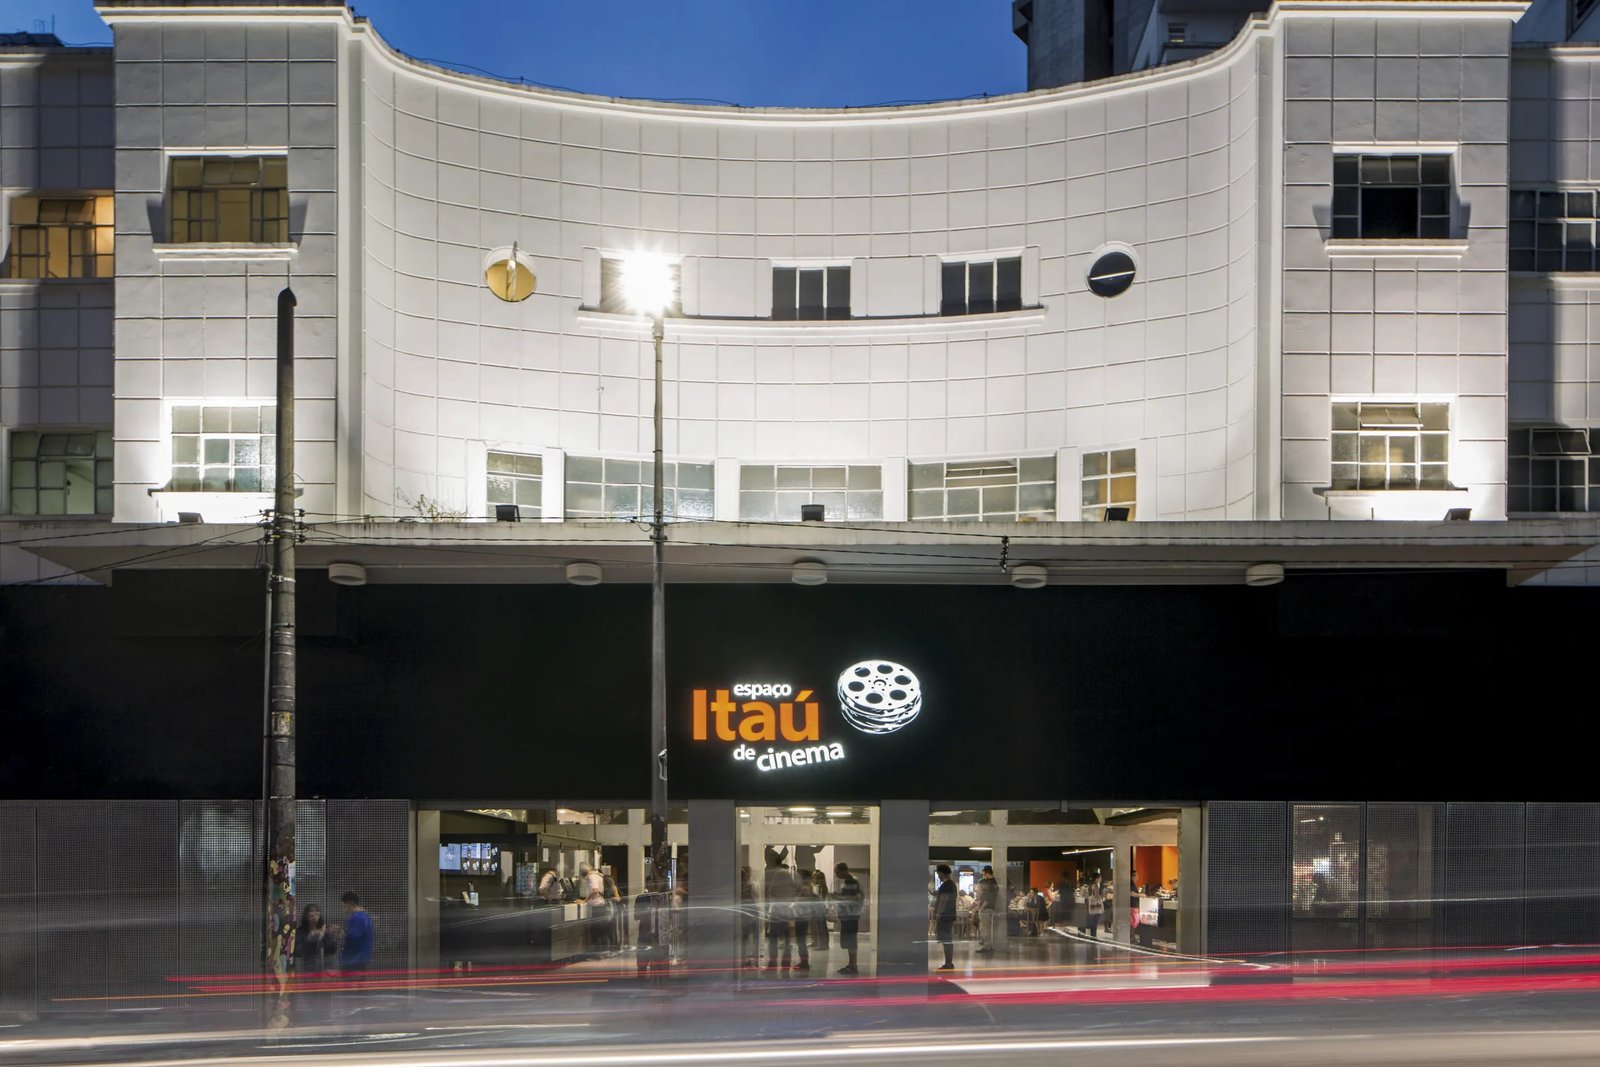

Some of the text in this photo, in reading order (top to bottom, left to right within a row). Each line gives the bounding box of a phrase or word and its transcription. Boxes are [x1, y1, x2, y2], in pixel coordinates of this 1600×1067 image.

[733, 683, 792, 700] espaço
[692, 689, 820, 742] Itaú
[732, 742, 845, 772] de cinema
